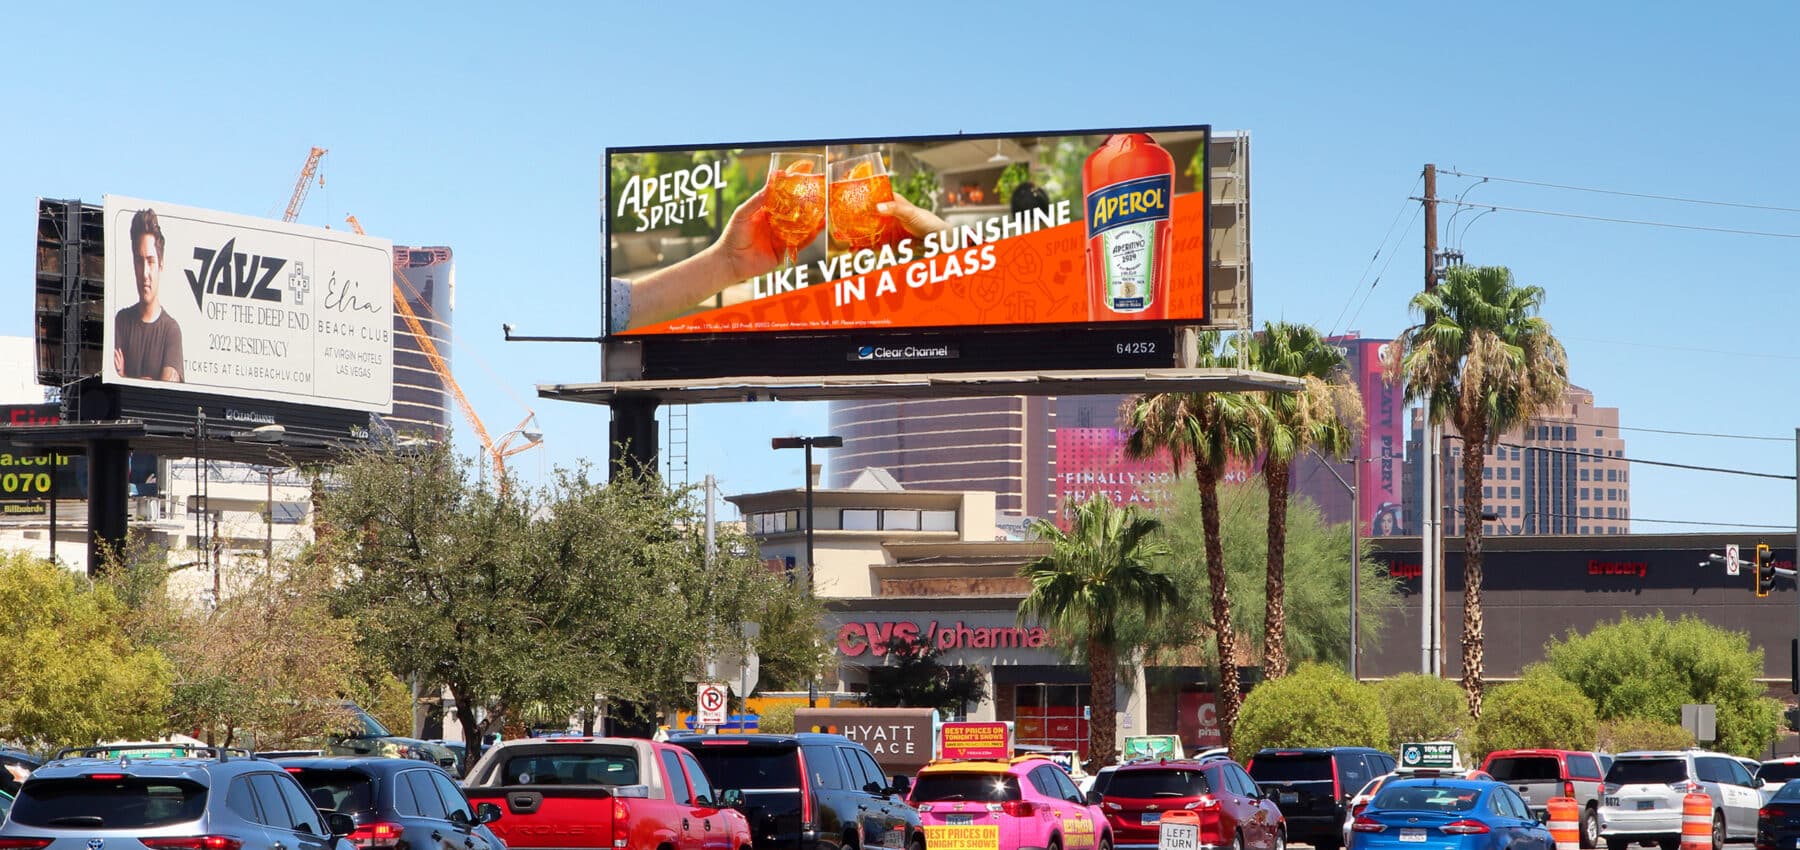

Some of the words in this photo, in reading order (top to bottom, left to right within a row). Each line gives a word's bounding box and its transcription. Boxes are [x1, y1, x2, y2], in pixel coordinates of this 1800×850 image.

[617, 160, 727, 217] APEROL
[1093, 188, 1165, 228] APEROL
[753, 264, 809, 300] LIKE
[817, 238, 913, 282] VEGAS
[923, 199, 1071, 259] SUNSHINE
[184, 236, 288, 314] JAUZ
[834, 276, 866, 307] IN
[875, 271, 897, 297] A
[905, 245, 997, 289] GLASS
[207, 301, 228, 320] OFF
[231, 304, 254, 324] THE
[257, 306, 284, 327] DEEP
[288, 310, 310, 331] END
[318, 320, 355, 336] BEACH
[361, 326, 389, 343] CLUB
[208, 332, 232, 352] 2022
[234, 336, 289, 358] RESIDENCY
[874, 347, 903, 358] Clear
[904, 345, 948, 357] Channel
[1116, 342, 1156, 354] 64252
[324, 347, 333, 357] AT
[333, 348, 356, 361] VIRGIN
[357, 352, 383, 365] HOTELS
[184, 359, 219, 374] TICKETS
[222, 363, 232, 374] AT
[235, 364, 312, 383] ELIABEACHLV.COM
[336, 365, 349, 375] LAS
[350, 366, 372, 379] VEGAS
[0, 452, 69, 466] a.com
[1381, 434, 1393, 495] PERRY
[0, 472, 52, 493] 070
[4, 504, 44, 513] Billboards
[1389, 560, 1423, 580] Liqu
[1588, 559, 1648, 578] Grocery
[837, 621, 920, 657] CVS
[844, 725, 915, 741] HYATT
[861, 742, 915, 754] ACE
[1424, 745, 1438, 753] 10%
[1438, 745, 1452, 753] OFF
[926, 828, 946, 839] BEST
[947, 828, 983, 839] PRICES
[983, 828, 996, 839] ON
[1166, 828, 1192, 839] LEFT
[926, 840, 965, 849] ONIGHT'S
[966, 840, 997, 848] SHOWS
[1166, 838, 1192, 849] TURN
